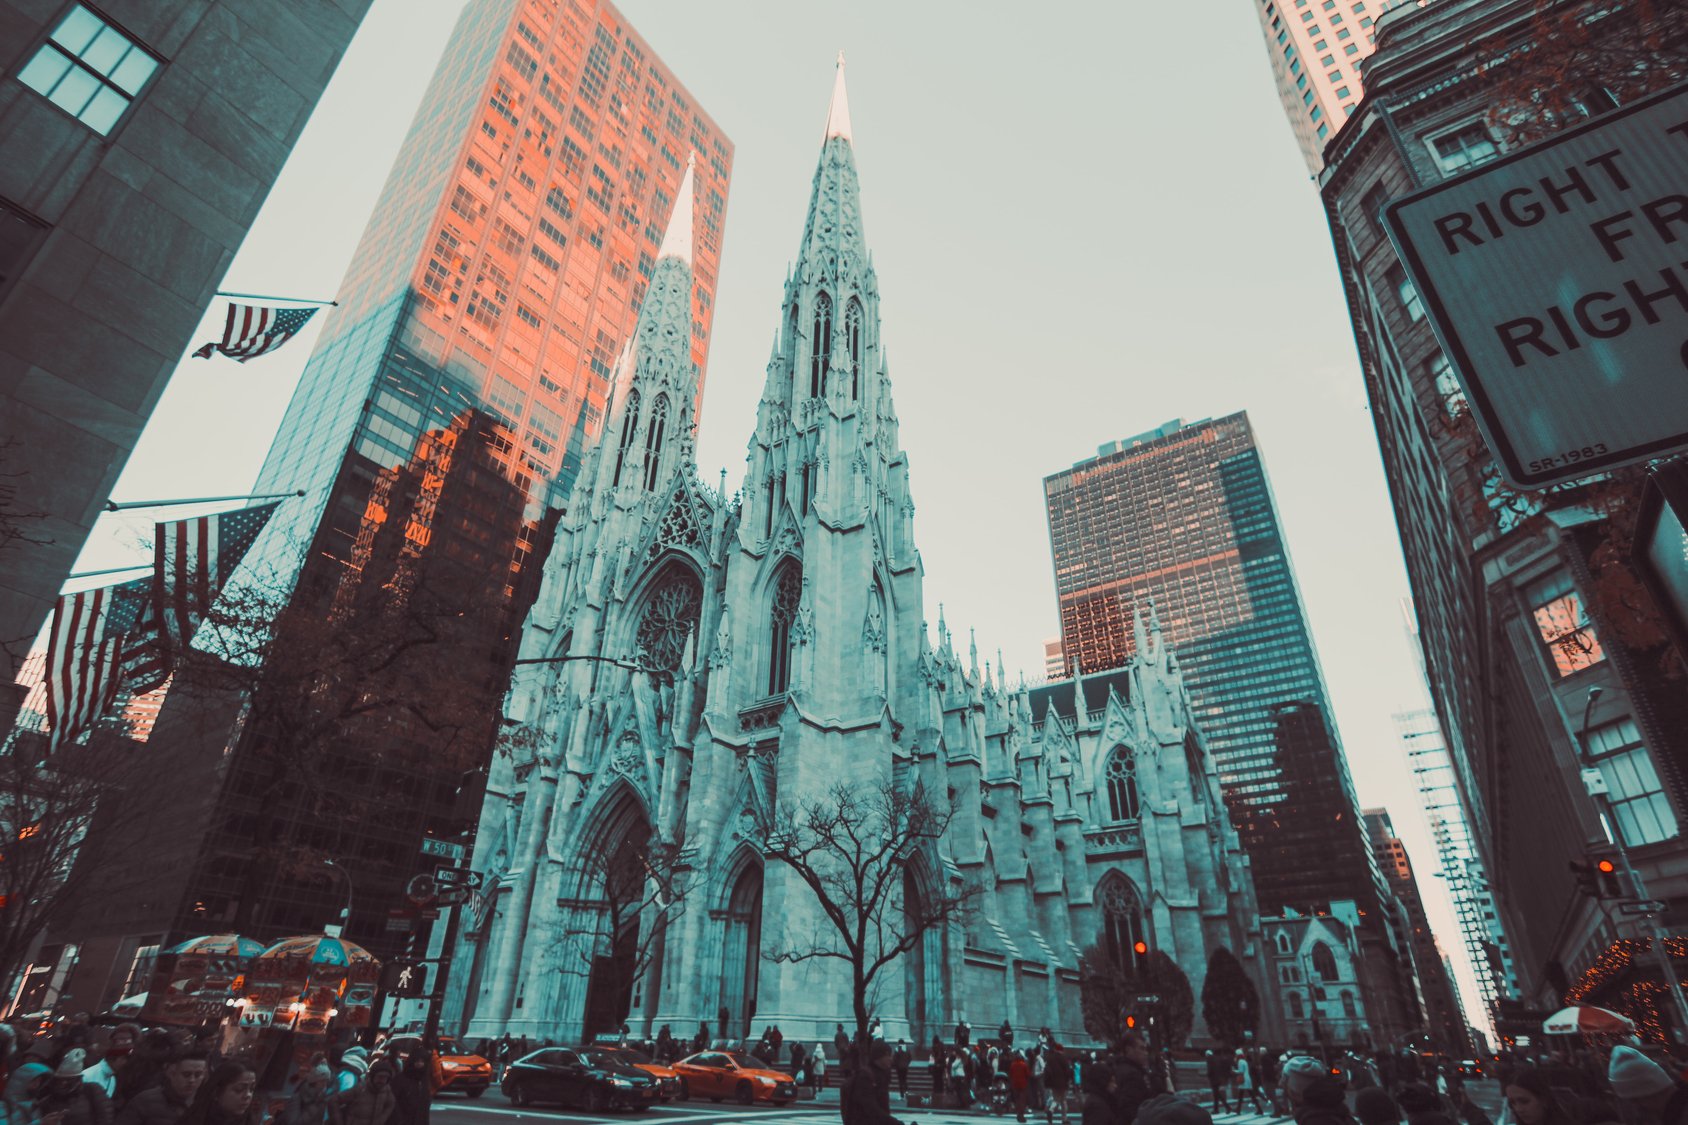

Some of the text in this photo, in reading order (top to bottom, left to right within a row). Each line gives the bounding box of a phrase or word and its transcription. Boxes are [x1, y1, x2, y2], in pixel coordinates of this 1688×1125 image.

[1433, 148, 1631, 256] RIGHT
[1494, 260, 1688, 368] RIGH
[1528, 442, 1609, 473] SR-1983
[423, 839, 432, 853] W
[433, 842, 447, 855] 50
